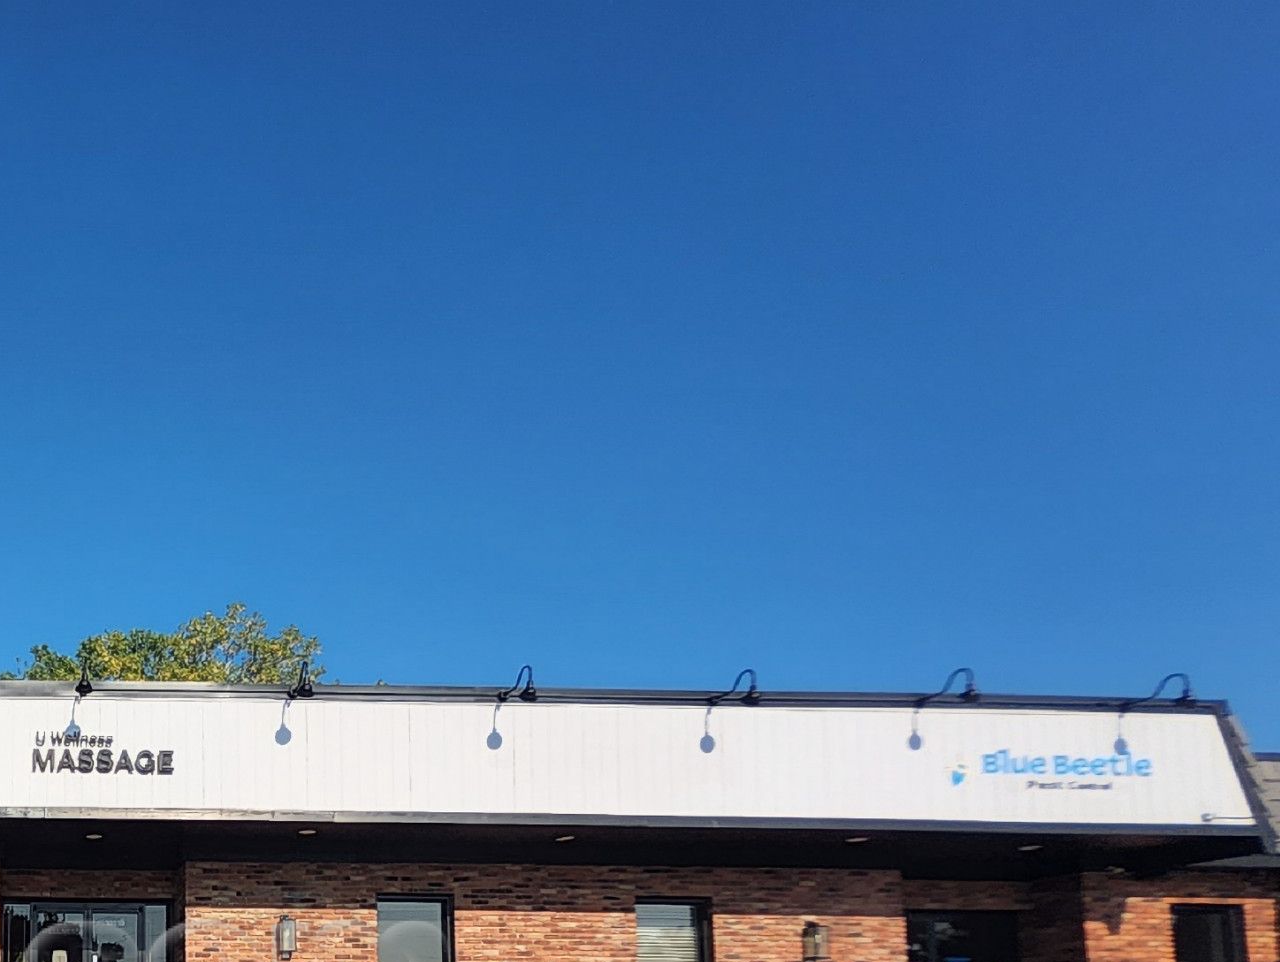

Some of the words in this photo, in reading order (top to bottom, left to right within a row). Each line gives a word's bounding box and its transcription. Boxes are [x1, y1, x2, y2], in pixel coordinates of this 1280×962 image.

[35, 730, 46, 747] U
[50, 730, 114, 748] Wellness
[31, 748, 175, 776] MASSAGE
[981, 748, 1046, 774] Blue
[1052, 754, 1153, 777] Beetle
